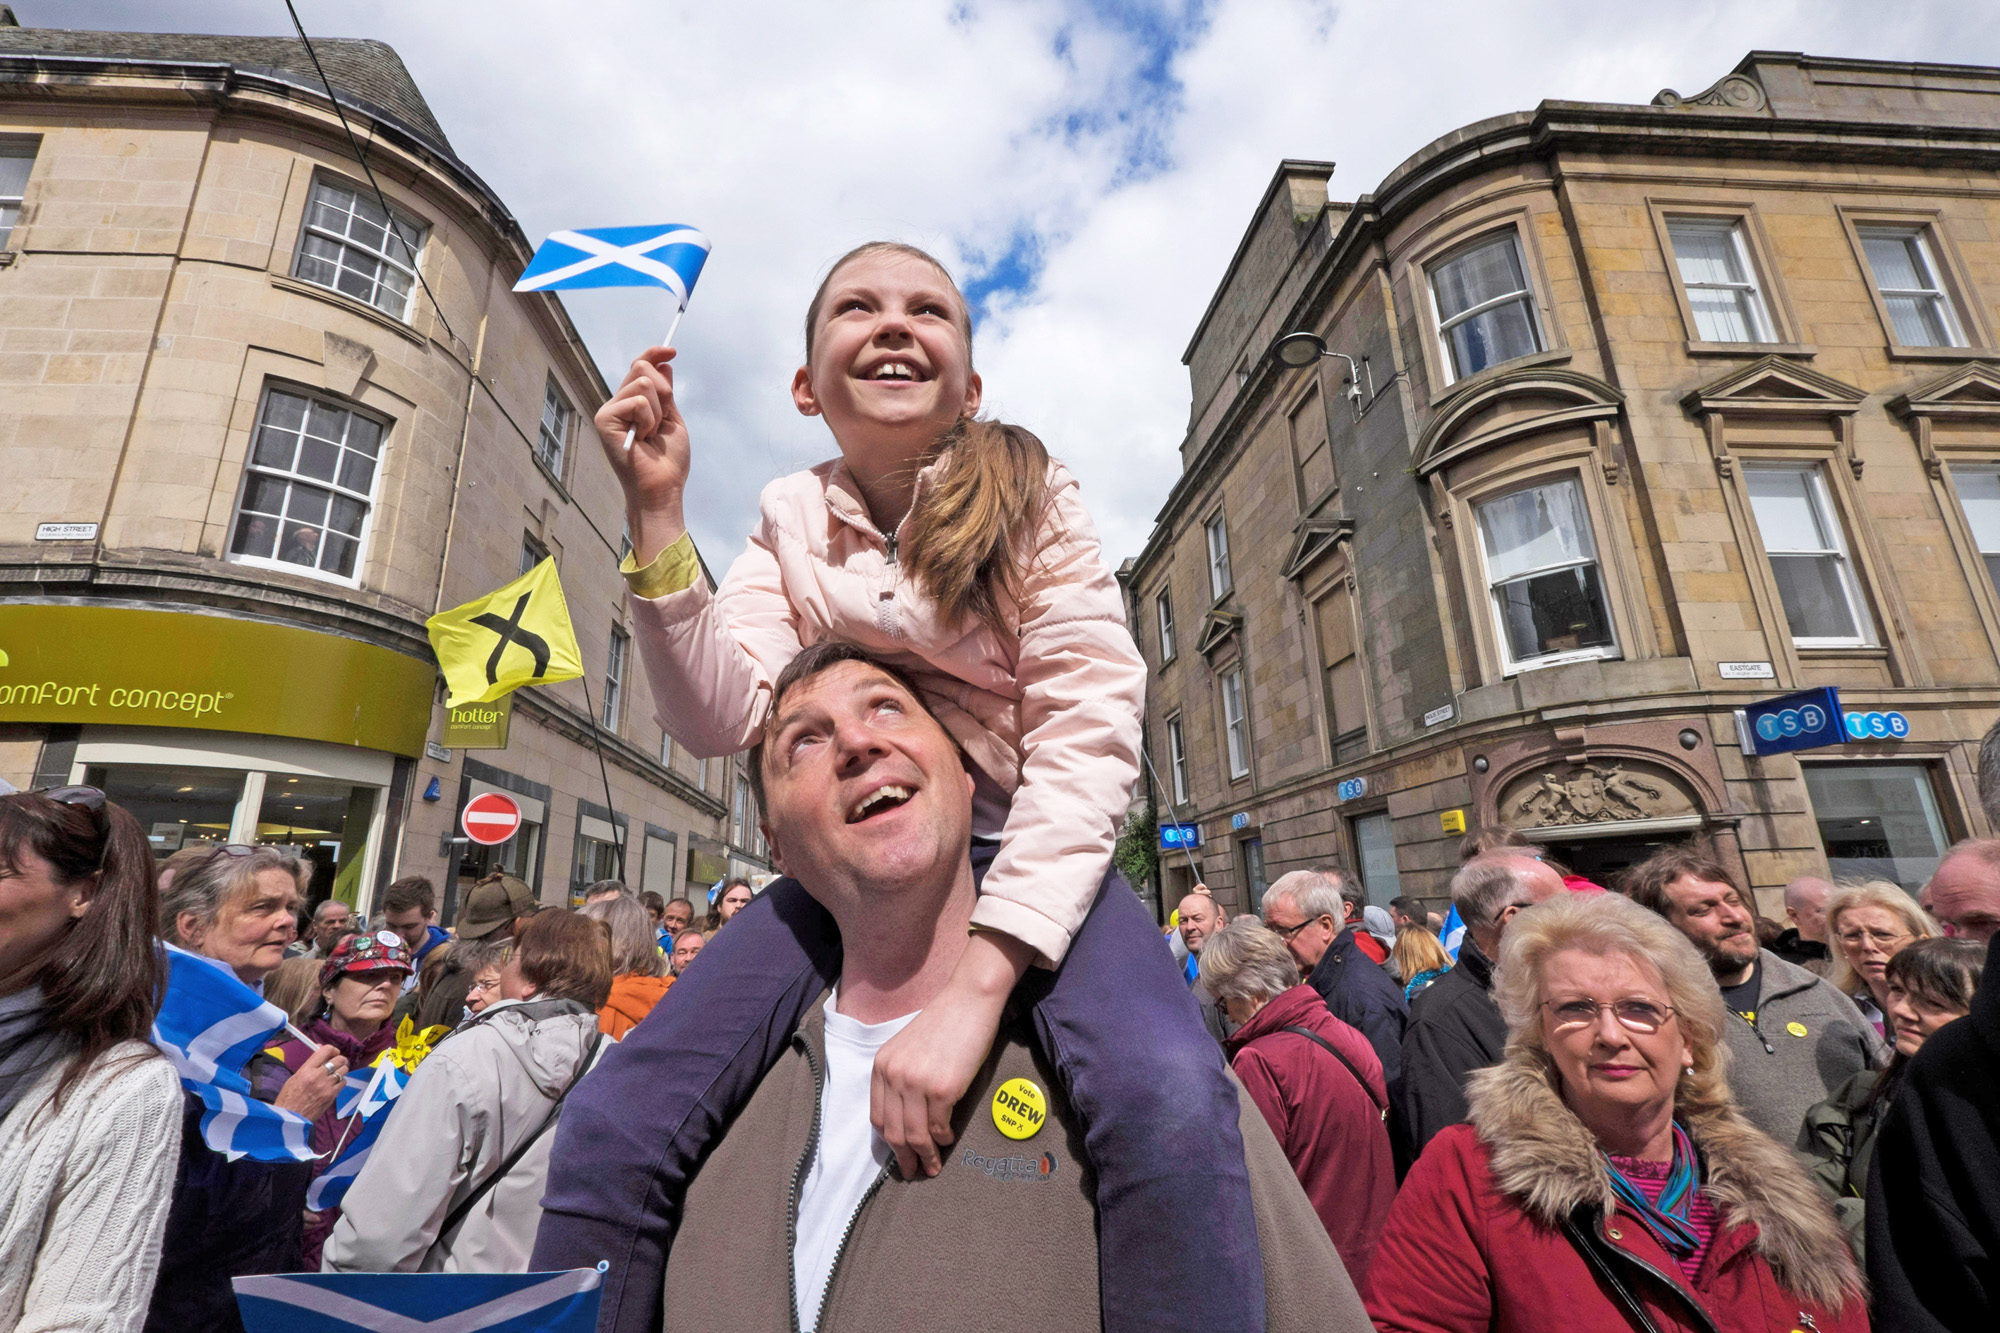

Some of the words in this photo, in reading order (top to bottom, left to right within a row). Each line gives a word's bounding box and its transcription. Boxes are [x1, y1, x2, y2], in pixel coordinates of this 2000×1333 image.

[0, 682, 100, 706] omfort
[451, 708, 504, 724] hotter
[1761, 708, 1822, 737] TSB
[1850, 714, 1907, 735] TSB
[1339, 780, 1362, 799] TSB
[1019, 1084, 1036, 1099] Vote
[996, 1090, 1044, 1125] DREW
[1001, 1114, 1017, 1127] SNP
[961, 1148, 1038, 1175] Regatta
